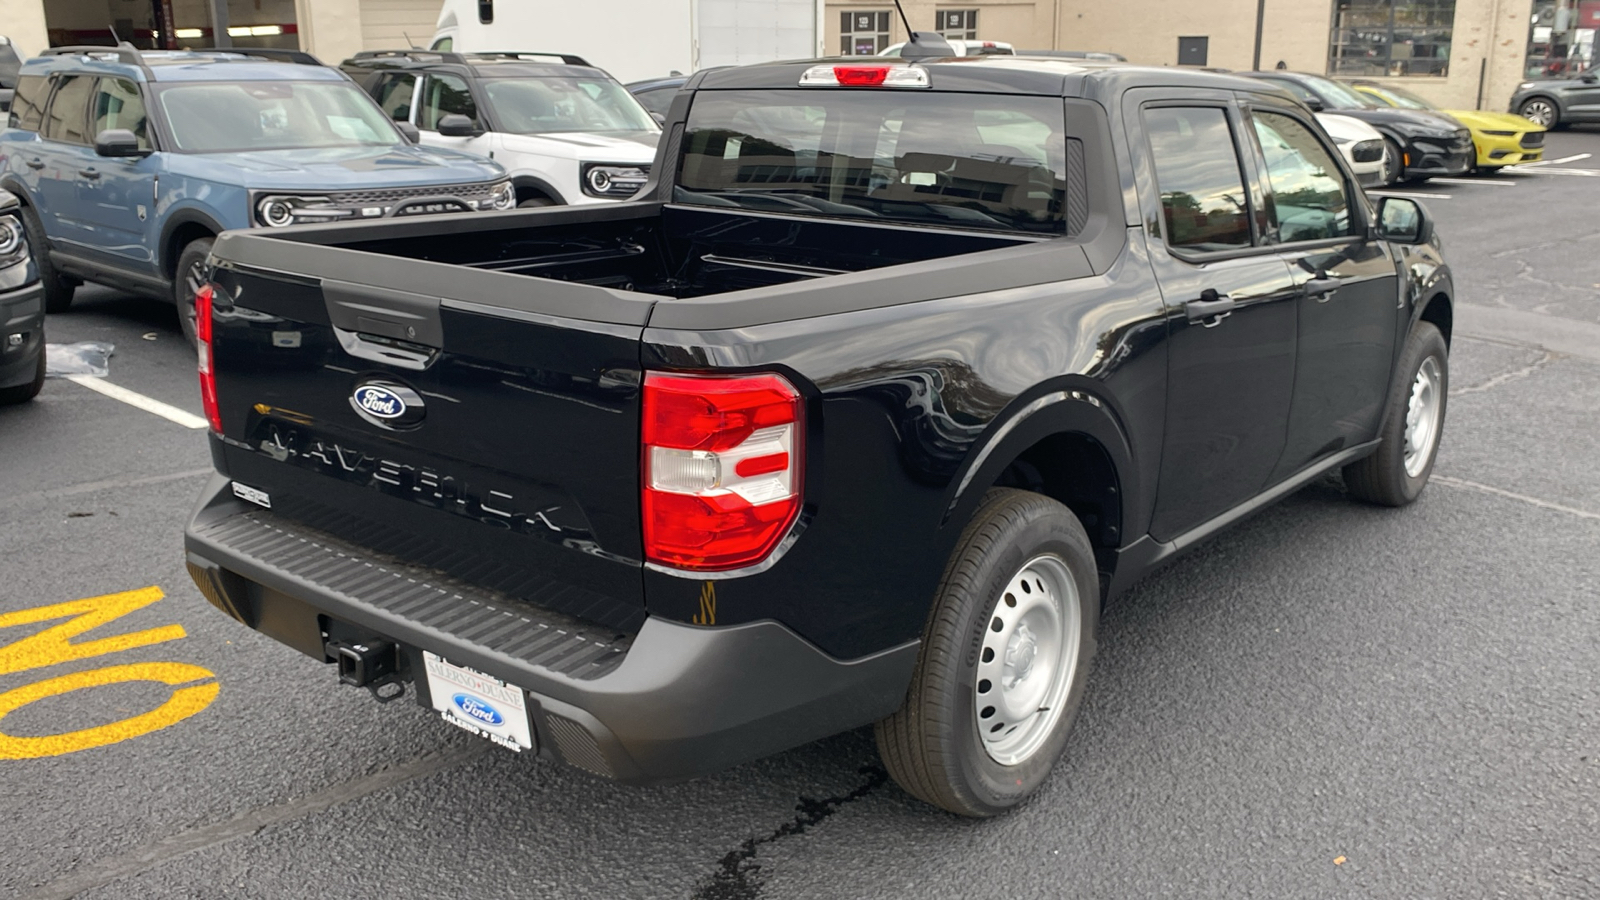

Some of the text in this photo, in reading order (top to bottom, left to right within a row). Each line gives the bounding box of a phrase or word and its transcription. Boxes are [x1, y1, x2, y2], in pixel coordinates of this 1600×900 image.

[363, 390, 395, 414] Ford
[267, 423, 562, 532] MAVERICK
[427, 660, 477, 691] SALERNO
[462, 697, 495, 723] Ford
